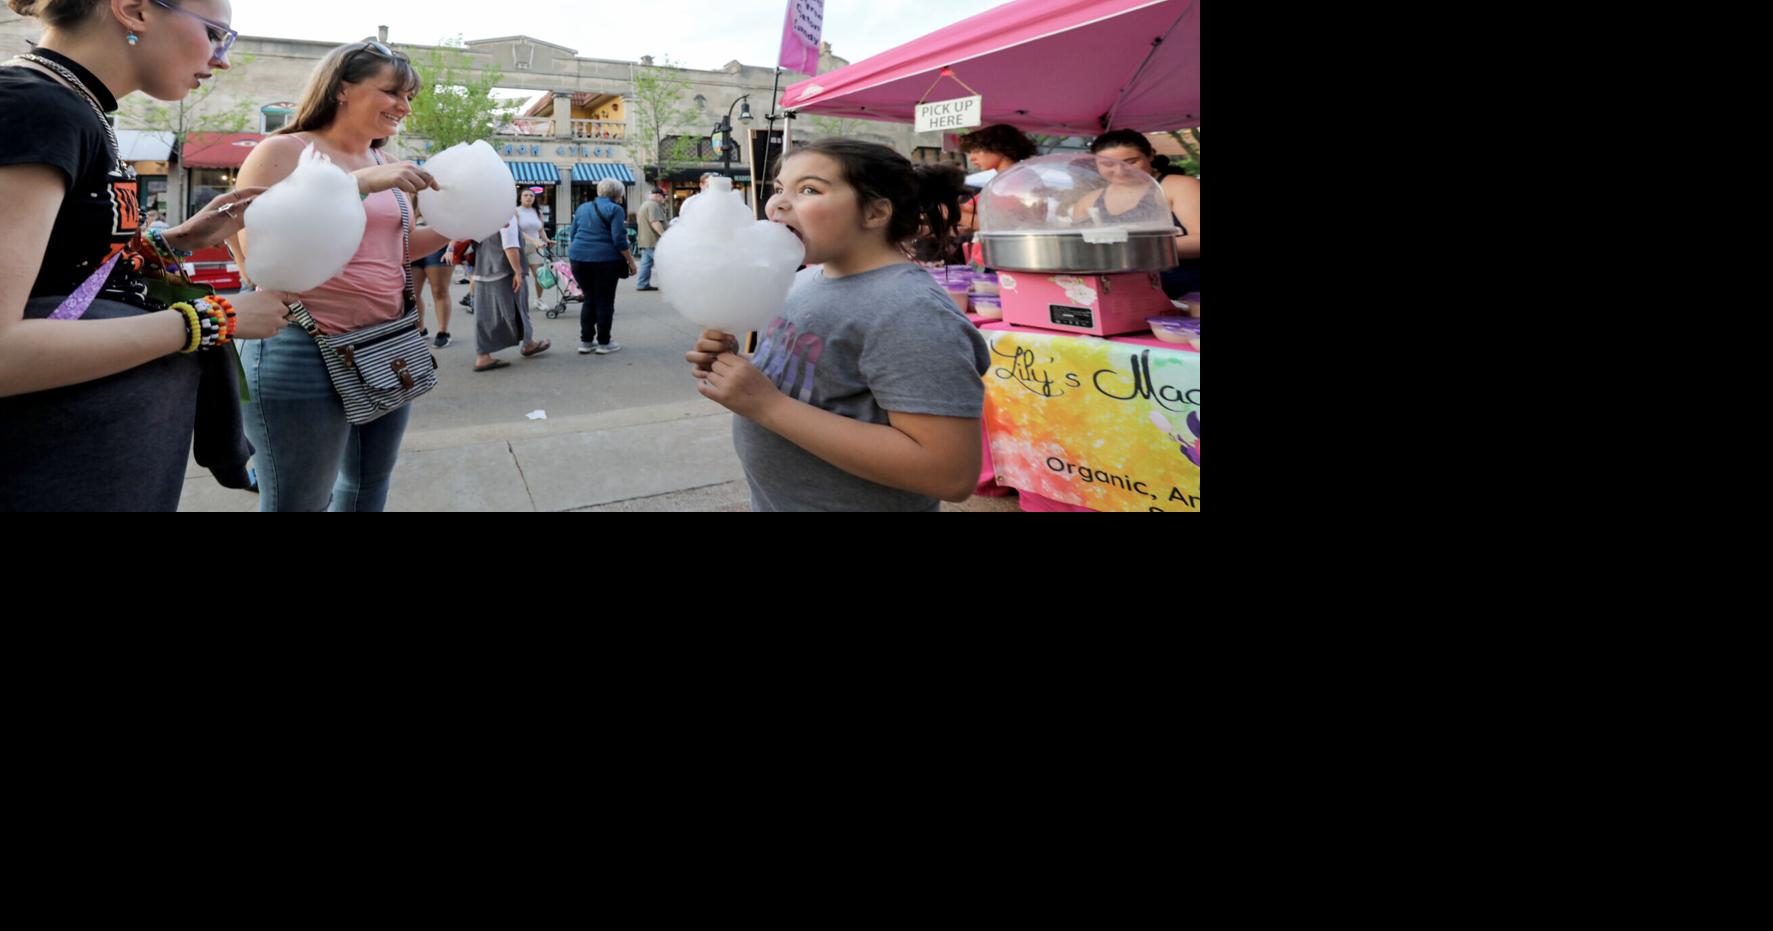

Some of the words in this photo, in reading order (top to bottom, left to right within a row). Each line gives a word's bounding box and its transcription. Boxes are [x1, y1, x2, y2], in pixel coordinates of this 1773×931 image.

[922, 103, 950, 117] PICK
[954, 100, 973, 113] UP
[929, 114, 963, 128] HERE
[990, 340, 1081, 397] Lily's
[1046, 456, 1157, 501] Organic,
